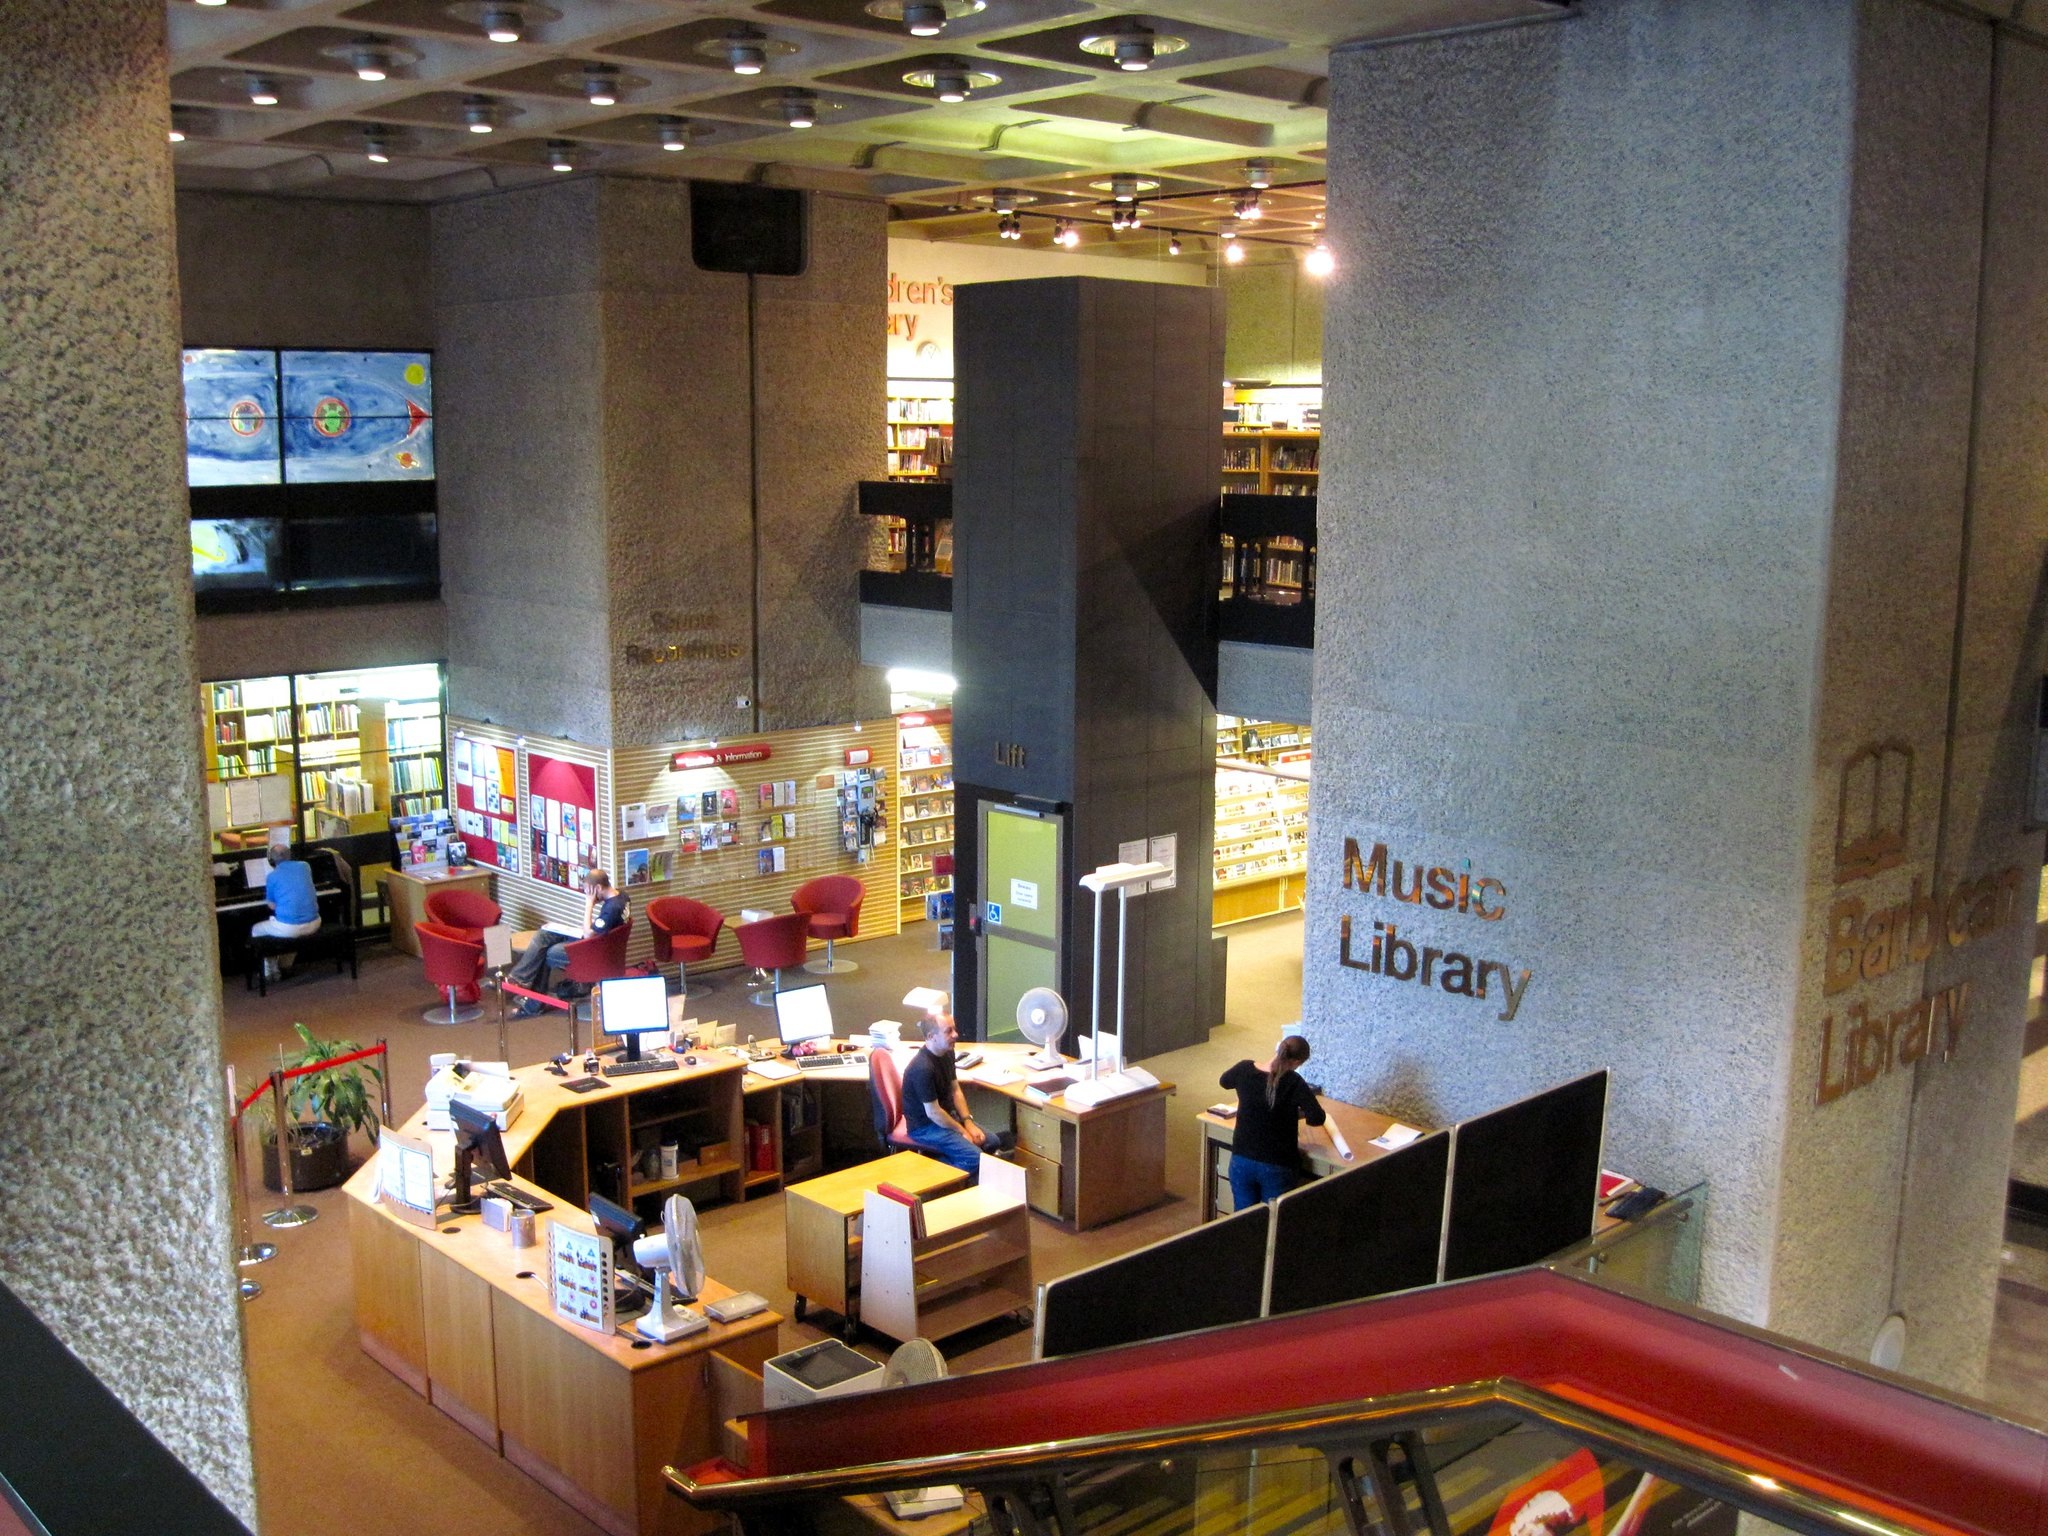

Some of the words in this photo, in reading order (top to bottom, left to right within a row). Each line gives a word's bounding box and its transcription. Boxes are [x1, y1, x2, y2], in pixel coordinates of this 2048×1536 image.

[725, 751, 763, 762] Information
[995, 741, 1025, 769] Lift
[1343, 836, 1507, 921] Music
[1339, 914, 1532, 1021] Library
[1823, 866, 2024, 998] Barbican
[1815, 980, 1977, 1106] Library
